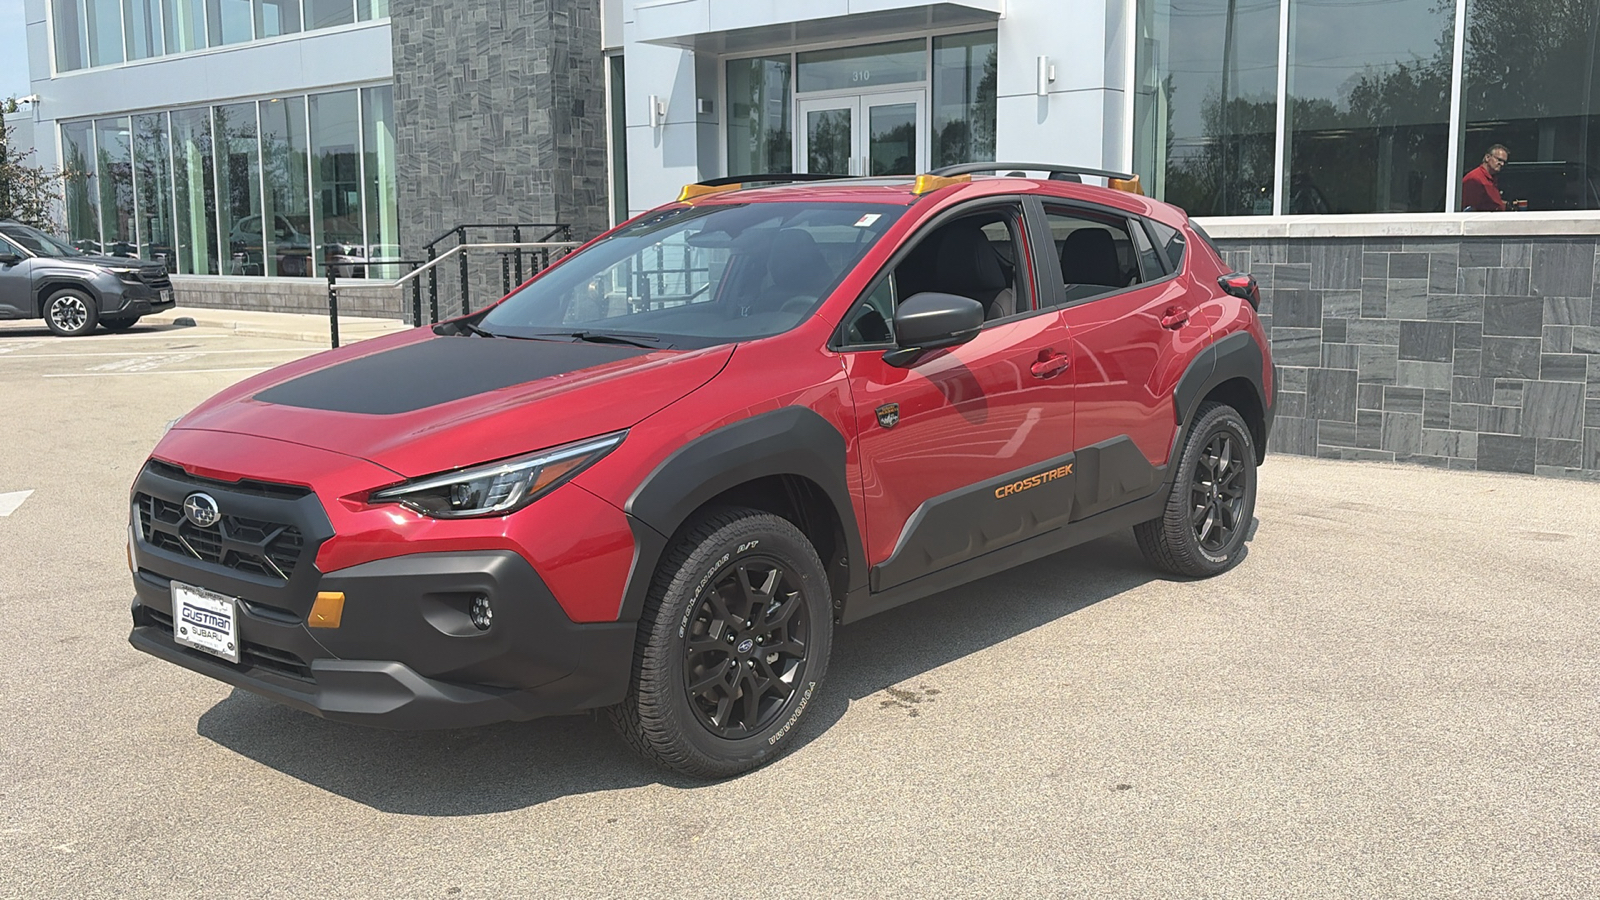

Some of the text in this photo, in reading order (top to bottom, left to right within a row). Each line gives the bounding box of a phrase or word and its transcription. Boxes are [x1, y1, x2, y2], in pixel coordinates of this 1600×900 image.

[852, 70, 870, 81] 310
[995, 463, 1073, 499] CROSSTREK
[679, 540, 759, 638] GEOLANDAR A/T
[191, 626, 223, 642] SUBARU
